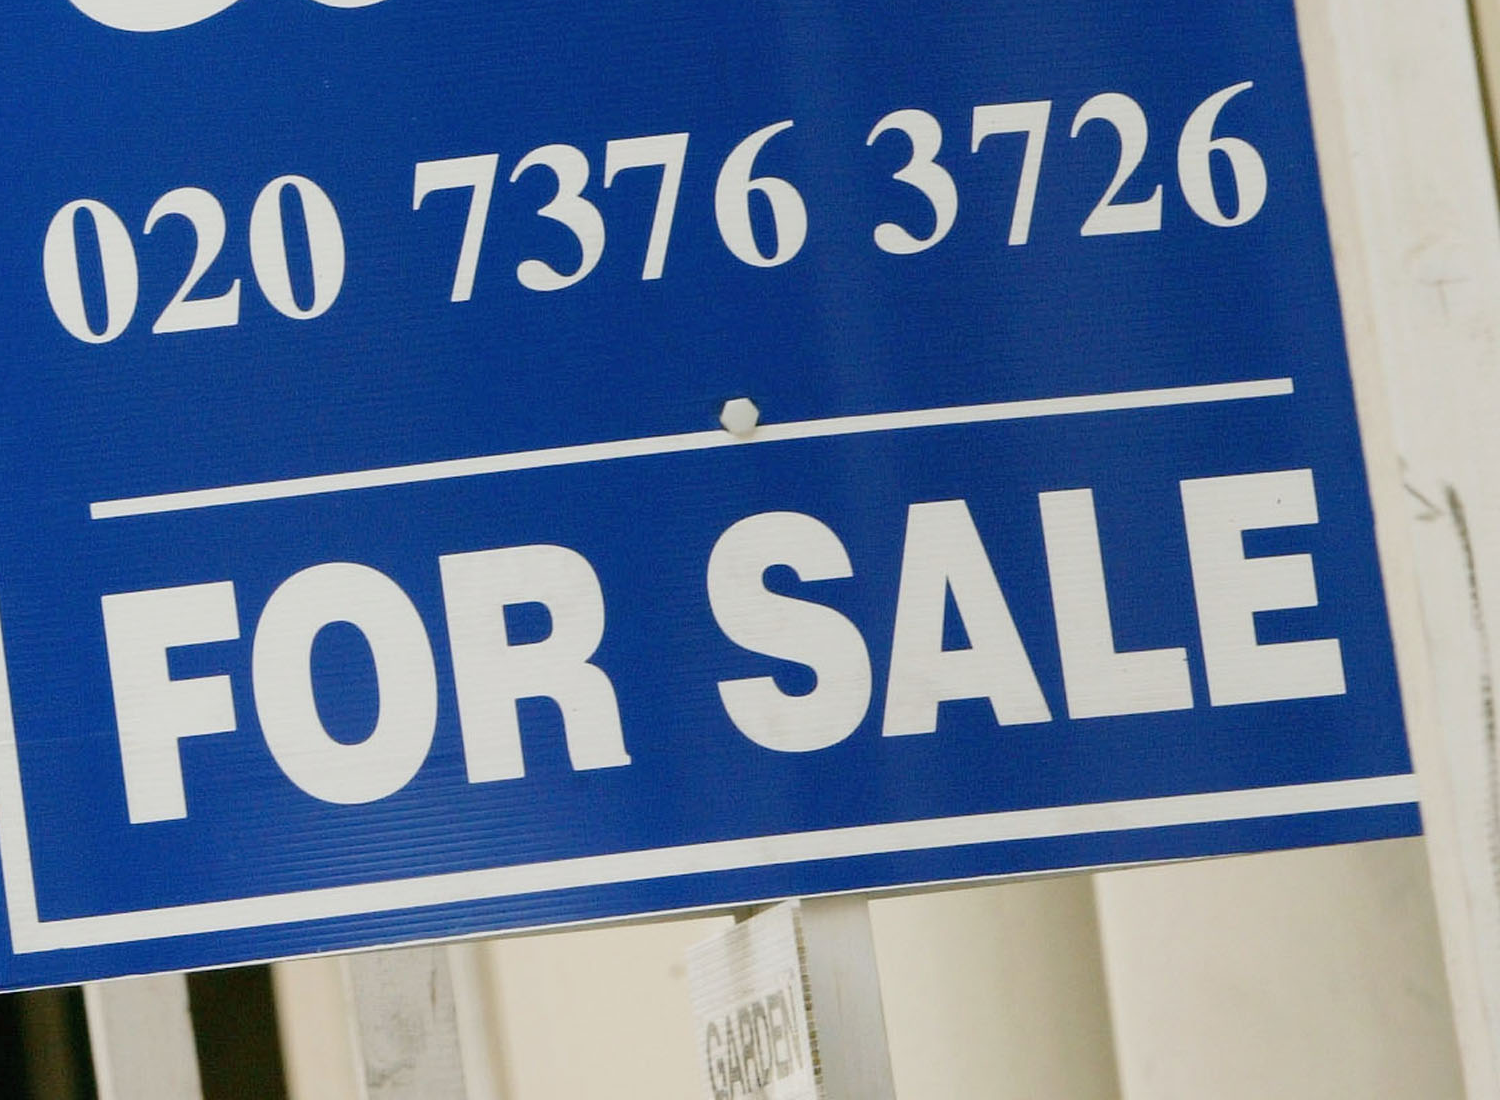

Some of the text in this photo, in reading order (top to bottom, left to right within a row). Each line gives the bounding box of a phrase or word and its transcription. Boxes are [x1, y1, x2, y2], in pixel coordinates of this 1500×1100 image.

[44, 82, 1266, 343] 020 7376 3726
[102, 469, 1345, 823] FOR SALE
